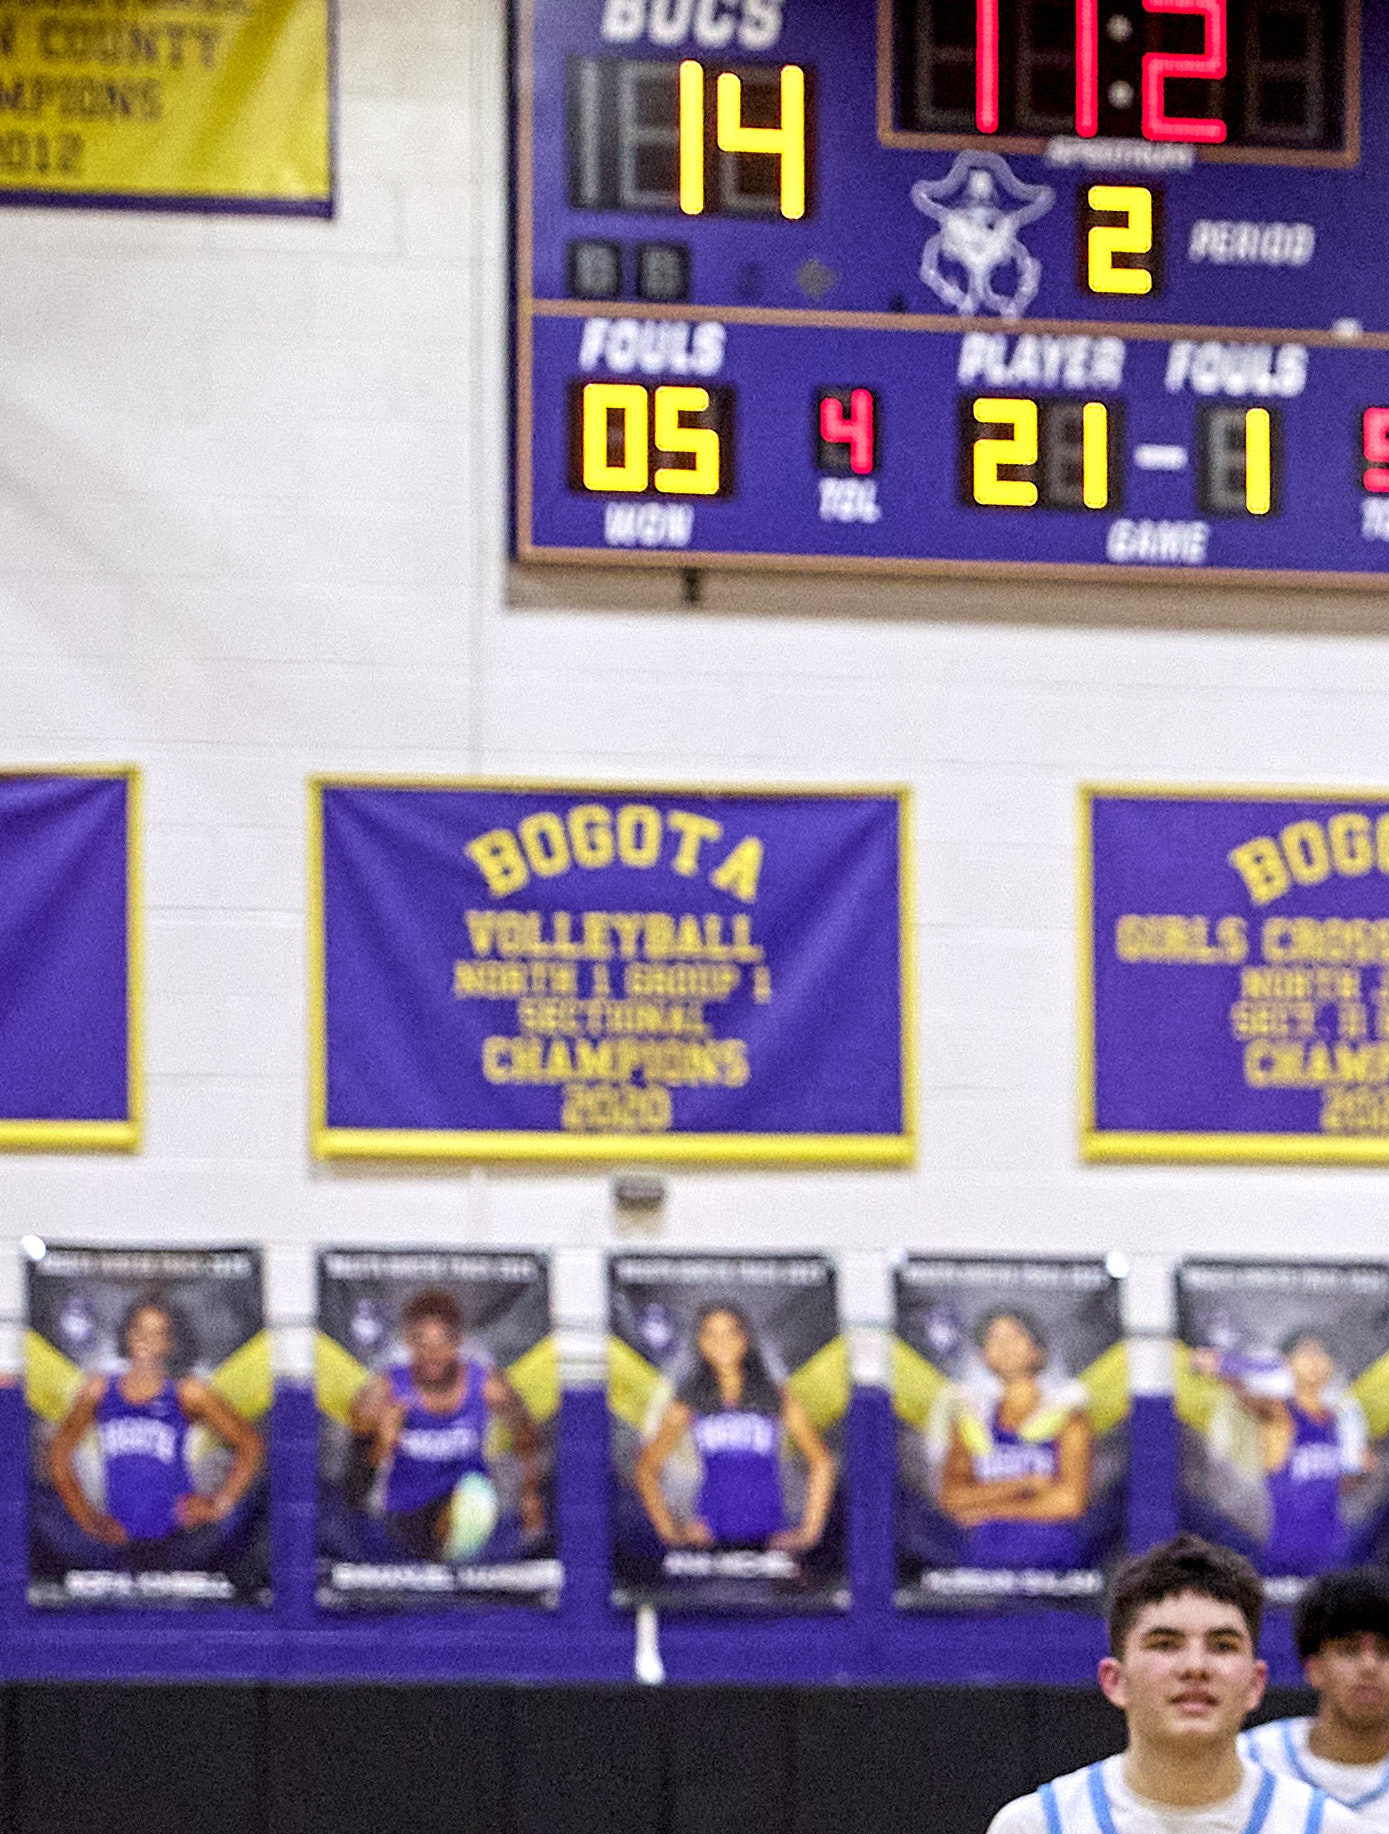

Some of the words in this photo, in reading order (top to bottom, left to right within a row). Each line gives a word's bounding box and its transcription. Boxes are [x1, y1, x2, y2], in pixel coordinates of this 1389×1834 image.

[679, 60, 805, 219] 14
[1087, 185, 1153, 294] 2
[1188, 218, 1316, 267] PERIOD
[579, 318, 726, 376] FOULS
[956, 331, 1126, 390] PLAYER
[1164, 339, 1309, 398] FOULS
[583, 383, 720, 496] 05
[819, 388, 874, 475] 4
[973, 397, 1109, 508] 21
[1245, 407, 1271, 516] 1
[1105, 517, 1213, 564] GAME
[463, 802, 766, 905] BOGOTA
[462, 908, 767, 963] VOLLEYBALL
[1114, 913, 1249, 966] GIRLS
[452, 959, 579, 1001] NORTH
[480, 1034, 753, 1088] CHAMPIONS
